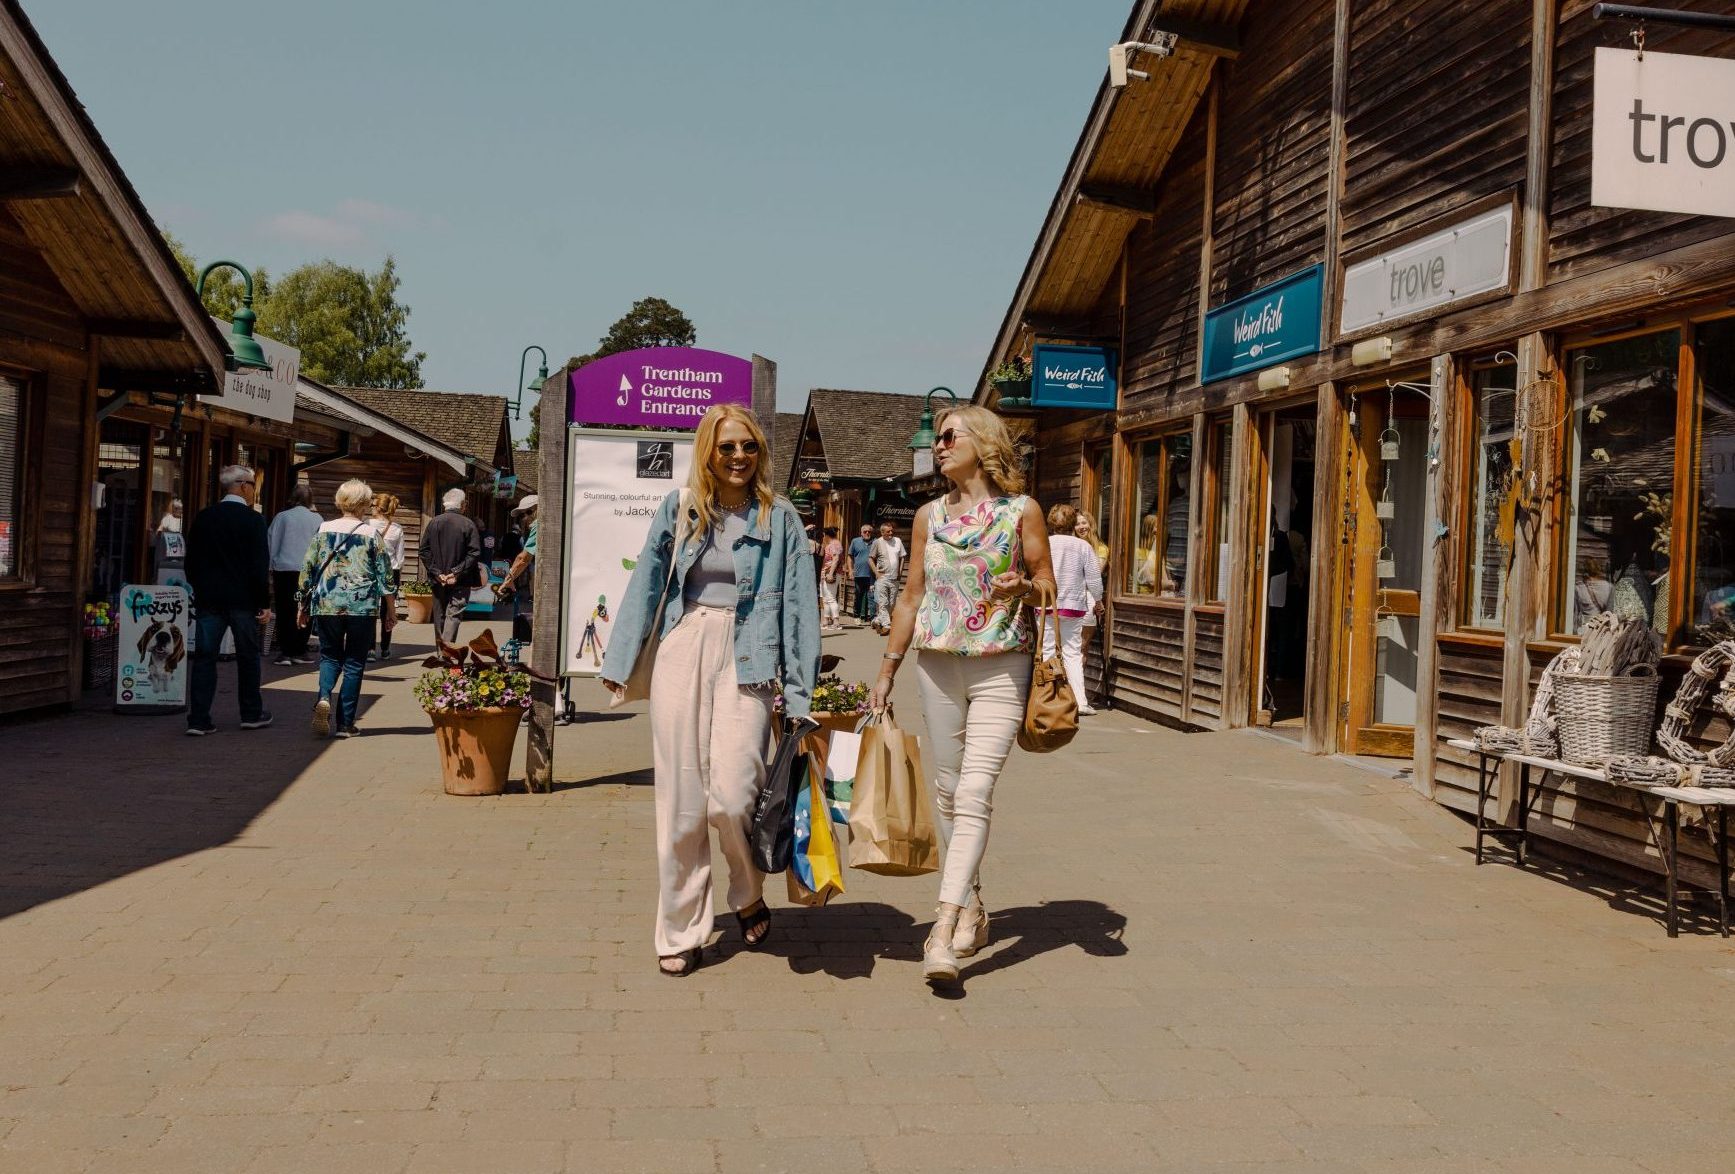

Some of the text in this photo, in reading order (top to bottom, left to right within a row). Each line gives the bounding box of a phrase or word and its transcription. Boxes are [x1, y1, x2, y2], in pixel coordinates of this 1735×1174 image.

[1628, 98, 1735, 169] tro
[1390, 255, 1445, 302] trove
[1234, 295, 1284, 344] Weird Fish
[641, 365, 723, 384] Trentham
[1045, 364, 1105, 383] Weird Fish
[232, 376, 272, 404] the dog shop
[641, 382, 712, 400] Gardens
[583, 491, 617, 502] Stunning,
[619, 493, 651, 502] colourful
[652, 494, 662, 502] art
[614, 505, 656, 519] by Jacky
